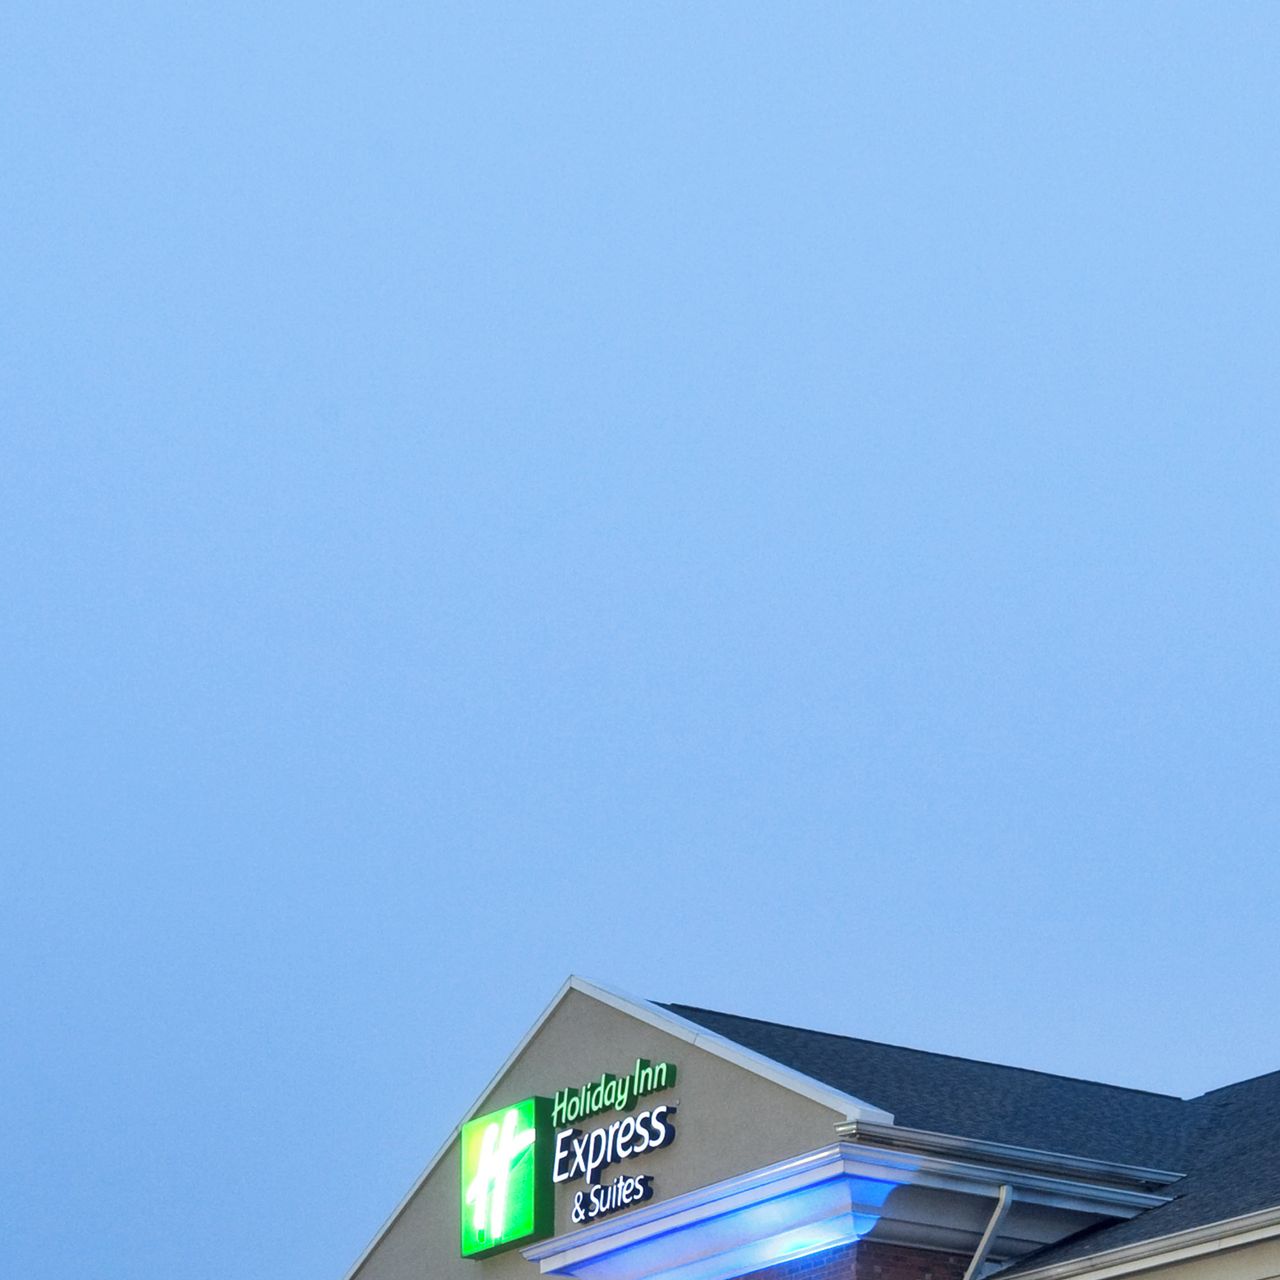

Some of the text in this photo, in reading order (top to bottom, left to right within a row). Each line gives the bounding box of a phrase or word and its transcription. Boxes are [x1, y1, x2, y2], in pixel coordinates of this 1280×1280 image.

[551, 1058, 668, 1128] Holiday Inn
[552, 1105, 668, 1185] Express
[571, 1175, 645, 1223] & Suites
